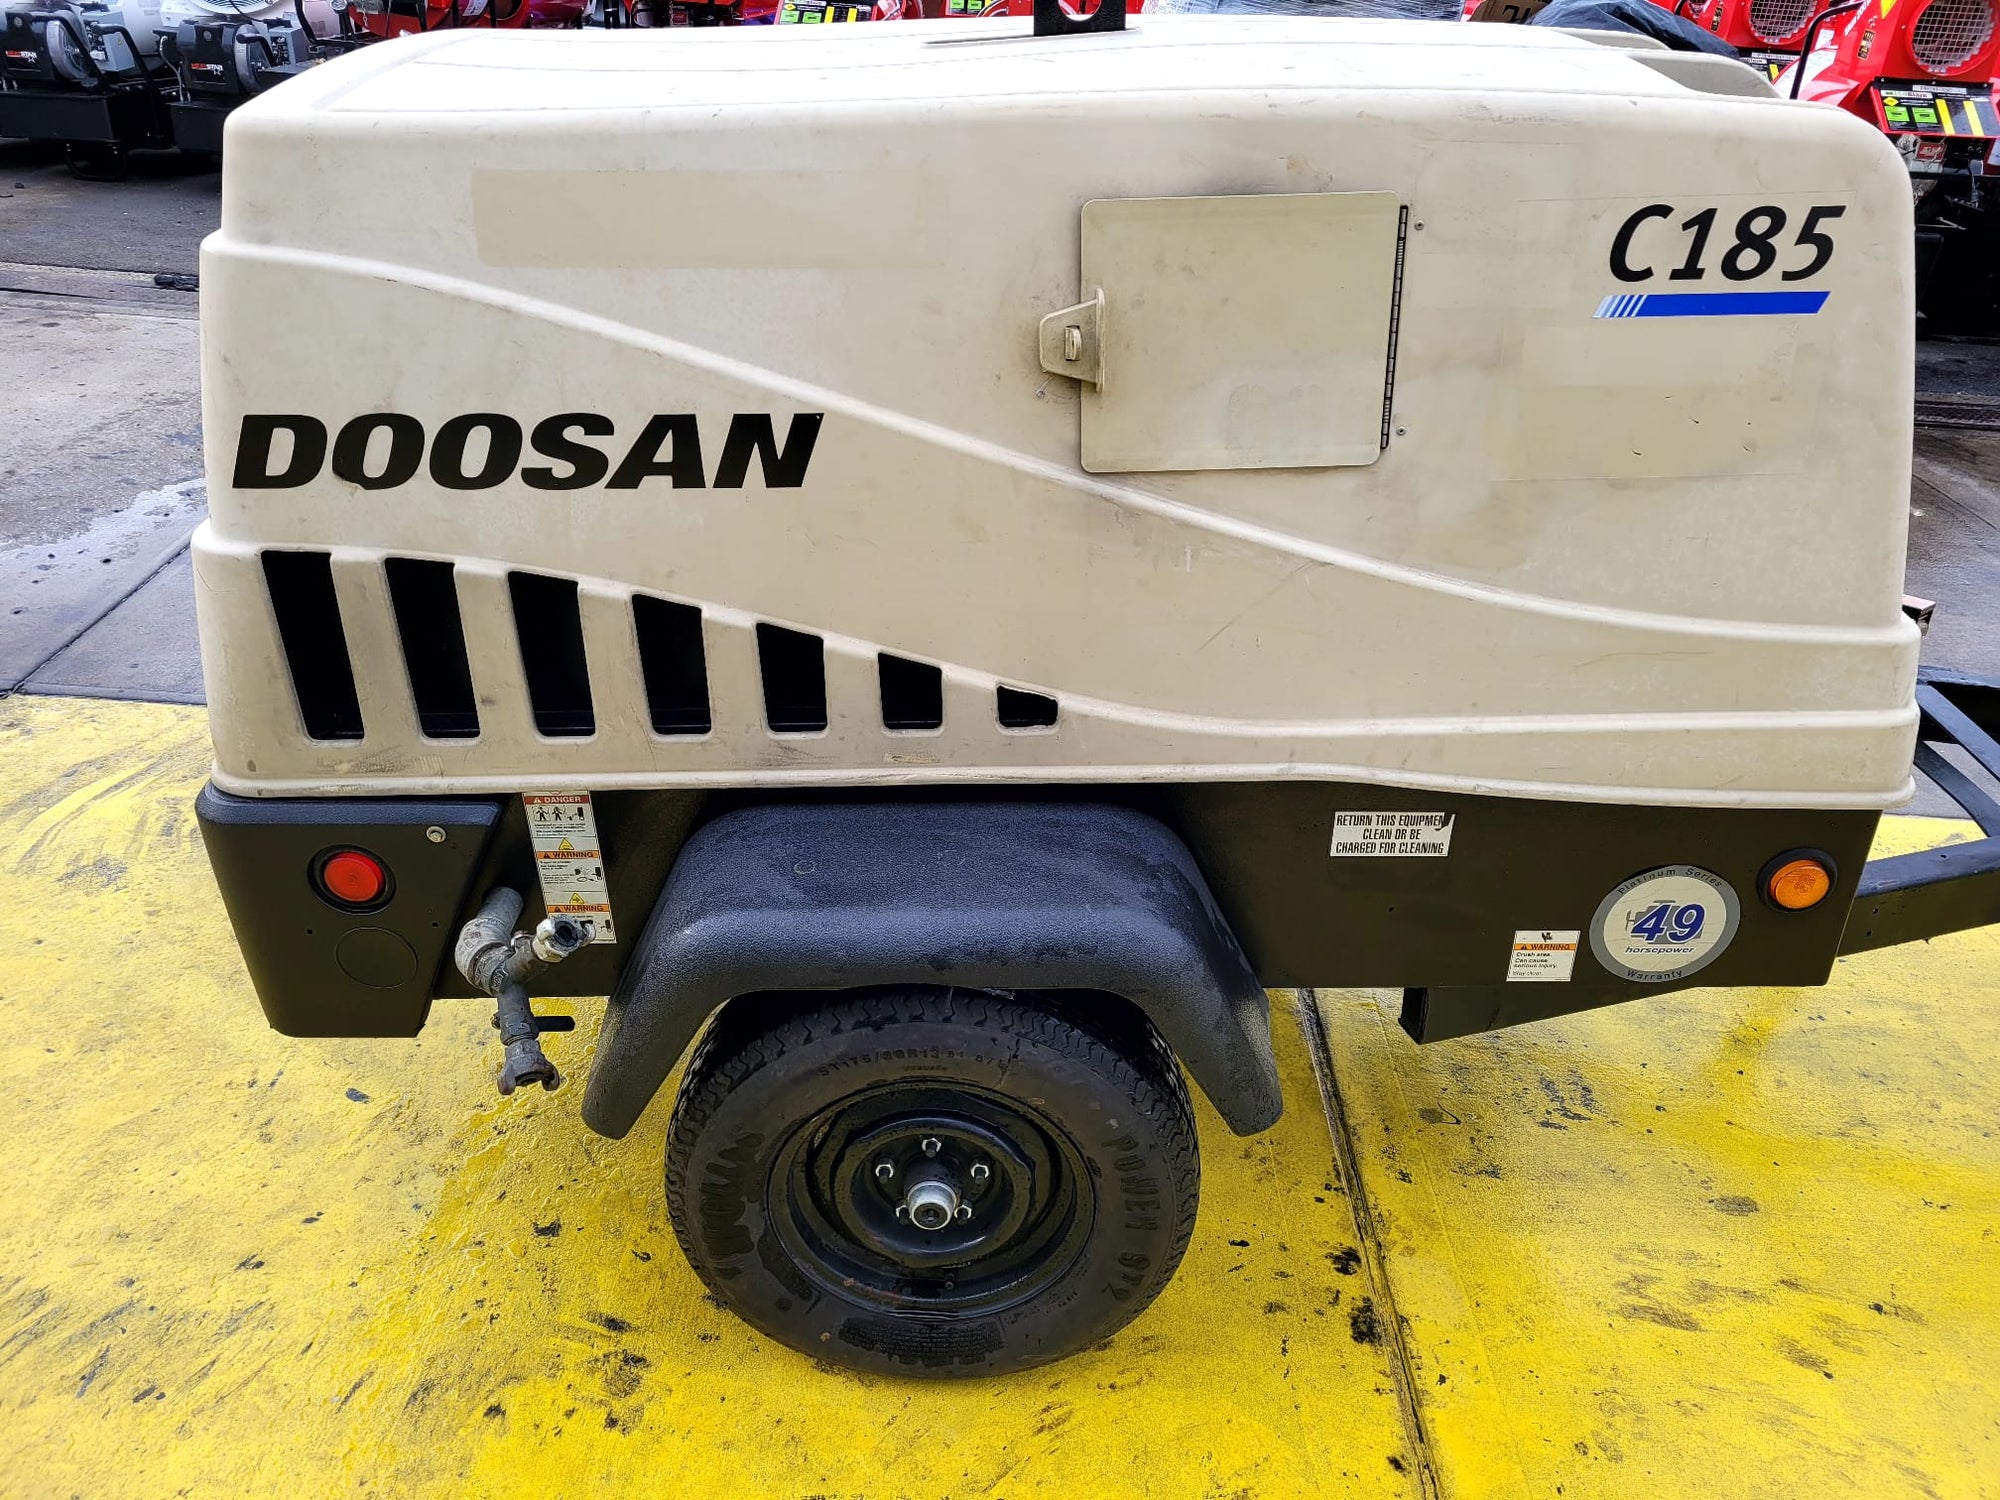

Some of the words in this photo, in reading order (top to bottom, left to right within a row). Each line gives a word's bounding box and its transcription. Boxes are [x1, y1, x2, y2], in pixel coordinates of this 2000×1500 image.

[1610, 204, 1847, 283] C185
[232, 412, 825, 490] DOOSAN
[1336, 814, 1373, 826] RETURN
[1376, 814, 1396, 826] THIS
[1398, 815, 1444, 827] EQUIPMEN
[1363, 828, 1393, 840] CLEAN
[1395, 828, 1408, 840] OR
[1409, 828, 1422, 840] BE
[1335, 842, 1376, 854] CHARGED
[1379, 842, 1396, 854] FOR
[1399, 842, 1444, 854] CLEANING
[554, 851, 594, 859] WARNING
[1617, 869, 1676, 894] Platinum
[1685, 867, 1722, 887] Series
[1630, 902, 1707, 943] 49
[1625, 946, 1695, 954] horsepower
[1626, 969, 1682, 980] Warranty
